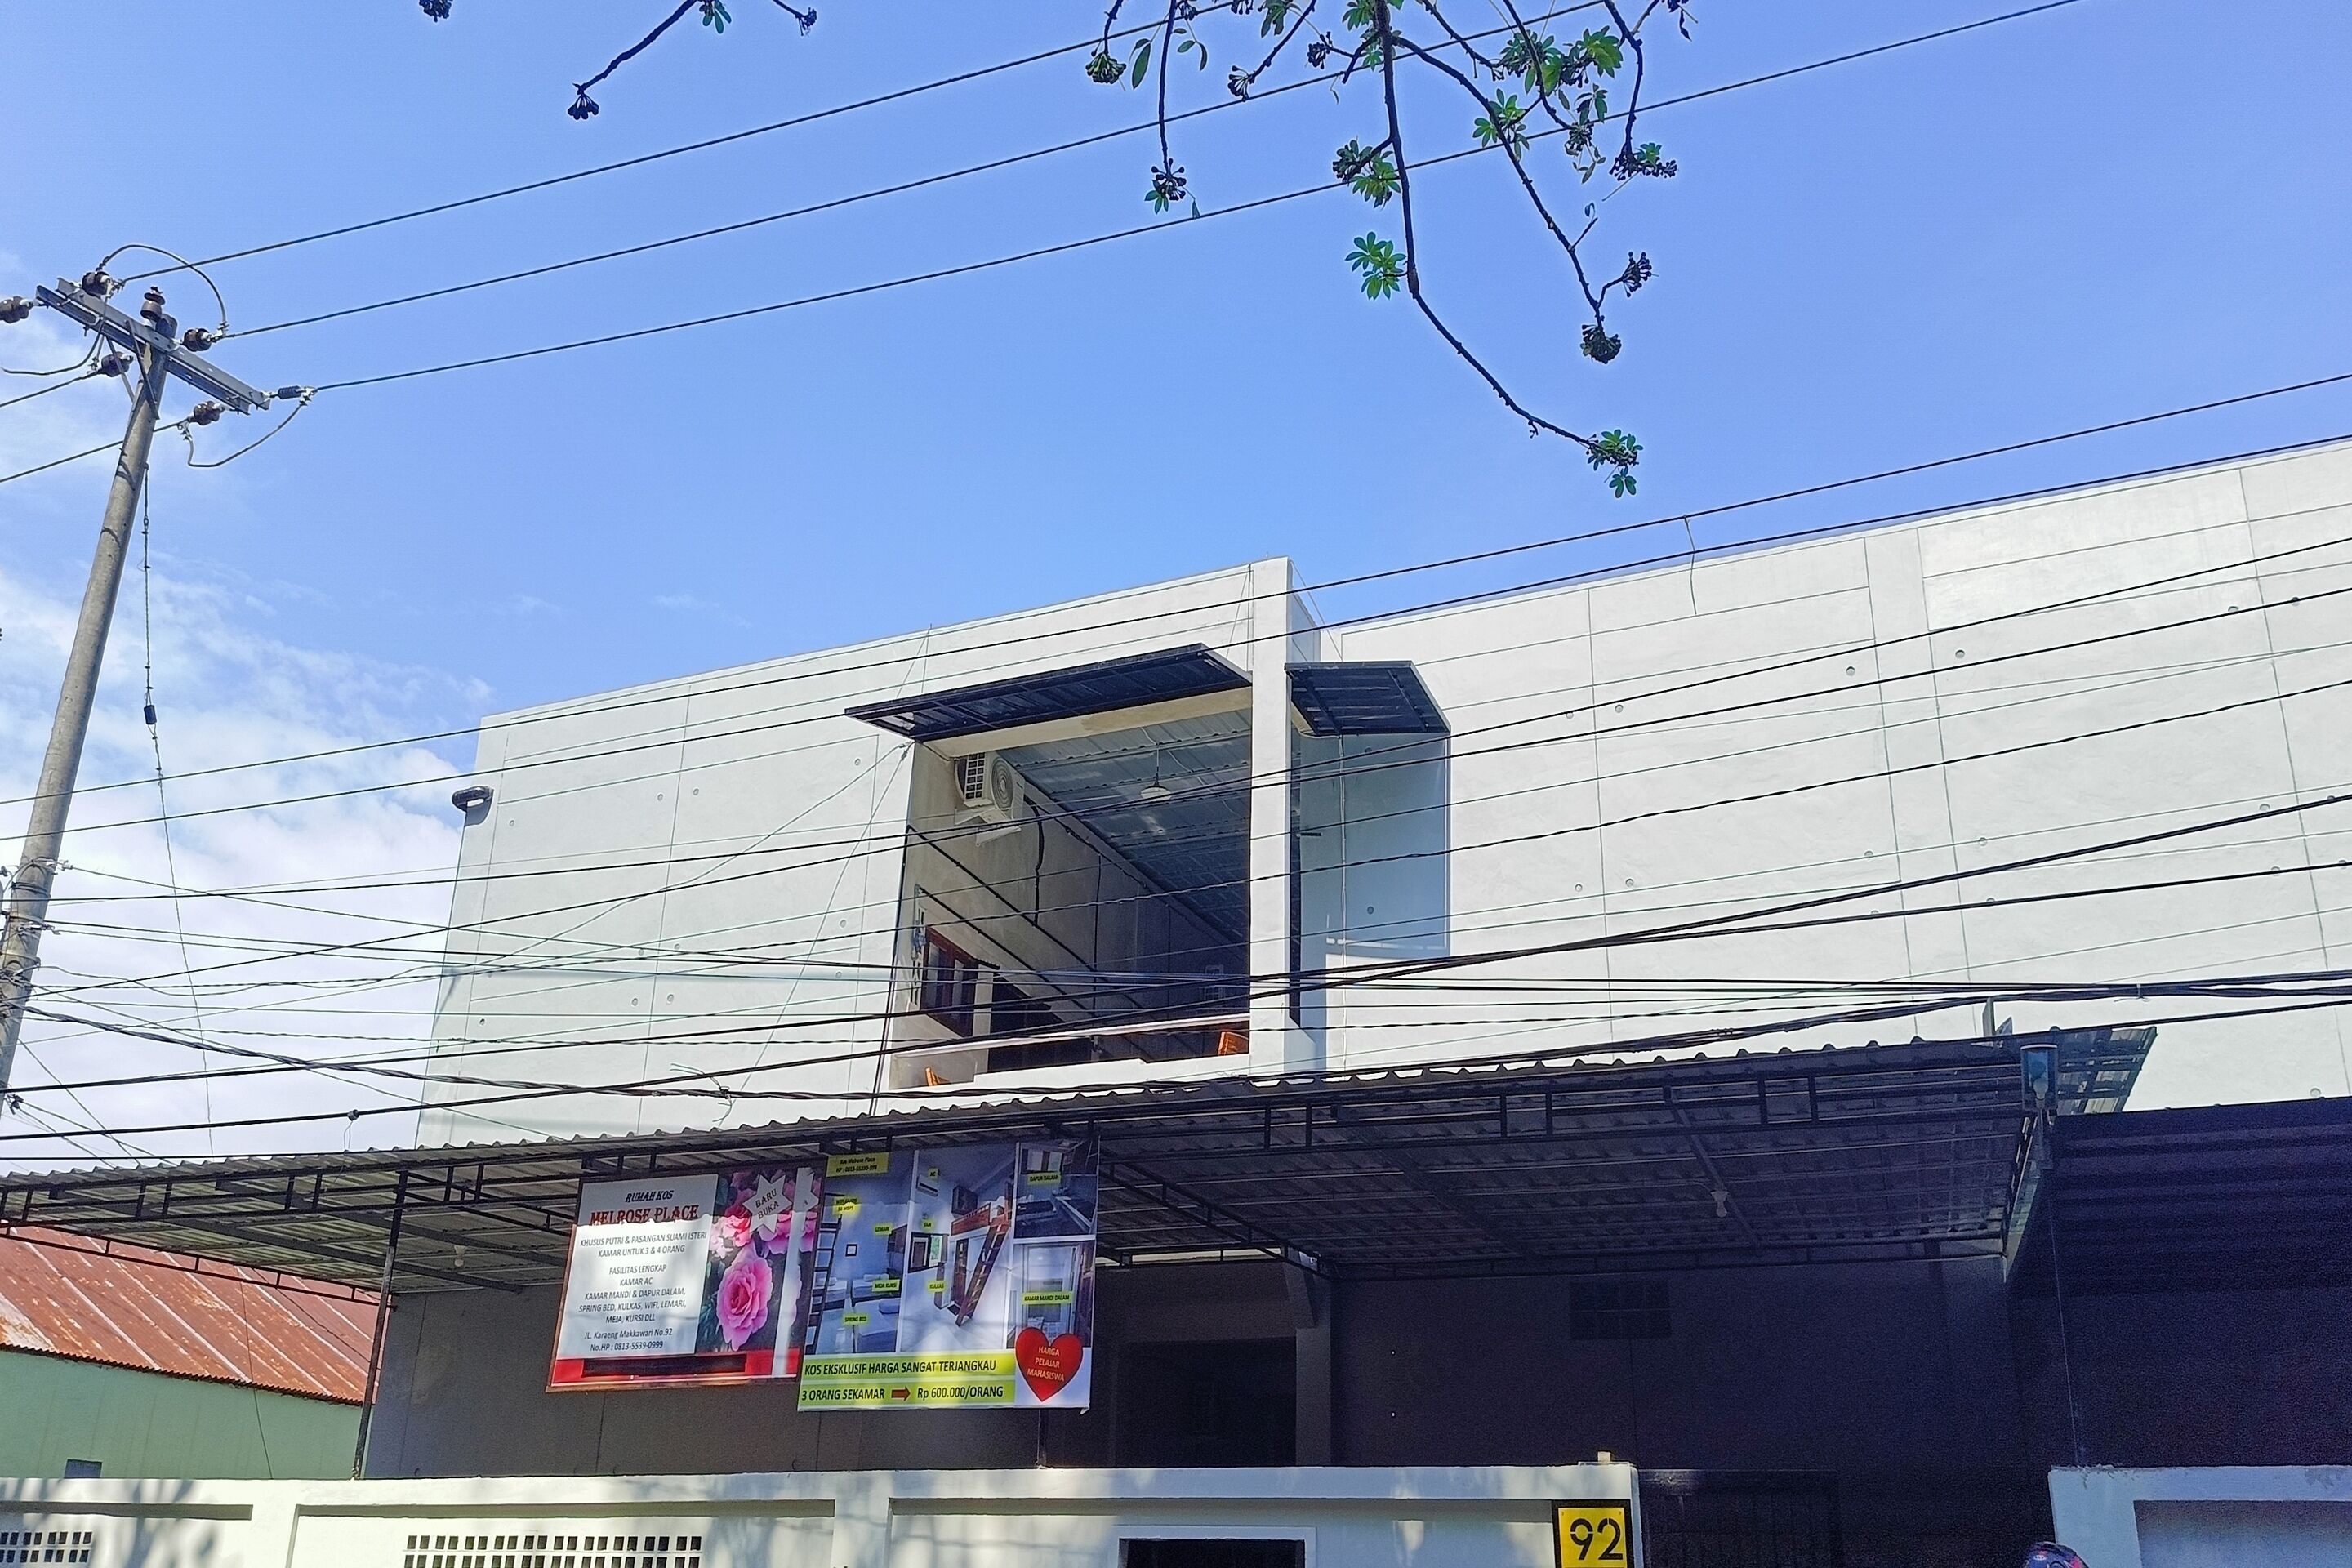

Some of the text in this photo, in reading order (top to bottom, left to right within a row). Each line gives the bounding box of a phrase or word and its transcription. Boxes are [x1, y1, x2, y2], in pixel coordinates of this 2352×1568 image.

[625, 1190, 674, 1203] RUMAH KOS
[755, 1188, 777, 1208] BARU
[589, 1205, 699, 1225] MELROSE PLACE
[758, 1201, 780, 1219] BUKA
[581, 1237, 604, 1247] KHUSUS
[605, 1236, 623, 1245] PUTRI
[631, 1233, 665, 1244] PASANGAN
[666, 1232, 687, 1241] SUAMI
[688, 1231, 707, 1240] ISTERI
[599, 1249, 621, 1257] KAMAR
[622, 1247, 644, 1256] UNTUK
[651, 1246, 657, 1254] &
[662, 1245, 685, 1254] ORANG
[609, 1264, 666, 1275] FASILITAS LENGKAP
[620, 1277, 643, 1285] KAMAR
[585, 1287, 685, 1300] KAMAR MANDI & DAPUR DALAM,
[579, 1299, 686, 1312] SPRING BED, KULKAS, WIFI, LEMARI,
[606, 1313, 655, 1324] MEJA, KURSI DLL
[584, 1328, 673, 1340] JL. Karaeng Makkawari No.92
[590, 1343, 610, 1351] No.HP
[614, 1340, 663, 1351] 0813-5539-0999
[1038, 1346, 1059, 1356] HARGA
[804, 1360, 996, 1375] KOS EKSKLUSIF HARGA SANGAT TERJANGKAU
[1035, 1357, 1060, 1368] PELAJAR
[1027, 1368, 1064, 1381] MAHASISWA
[801, 1385, 1004, 1401] 3 ORANG SEKAMAR Rp 600.000/ORANG
[1570, 1518, 1623, 1560] 92
